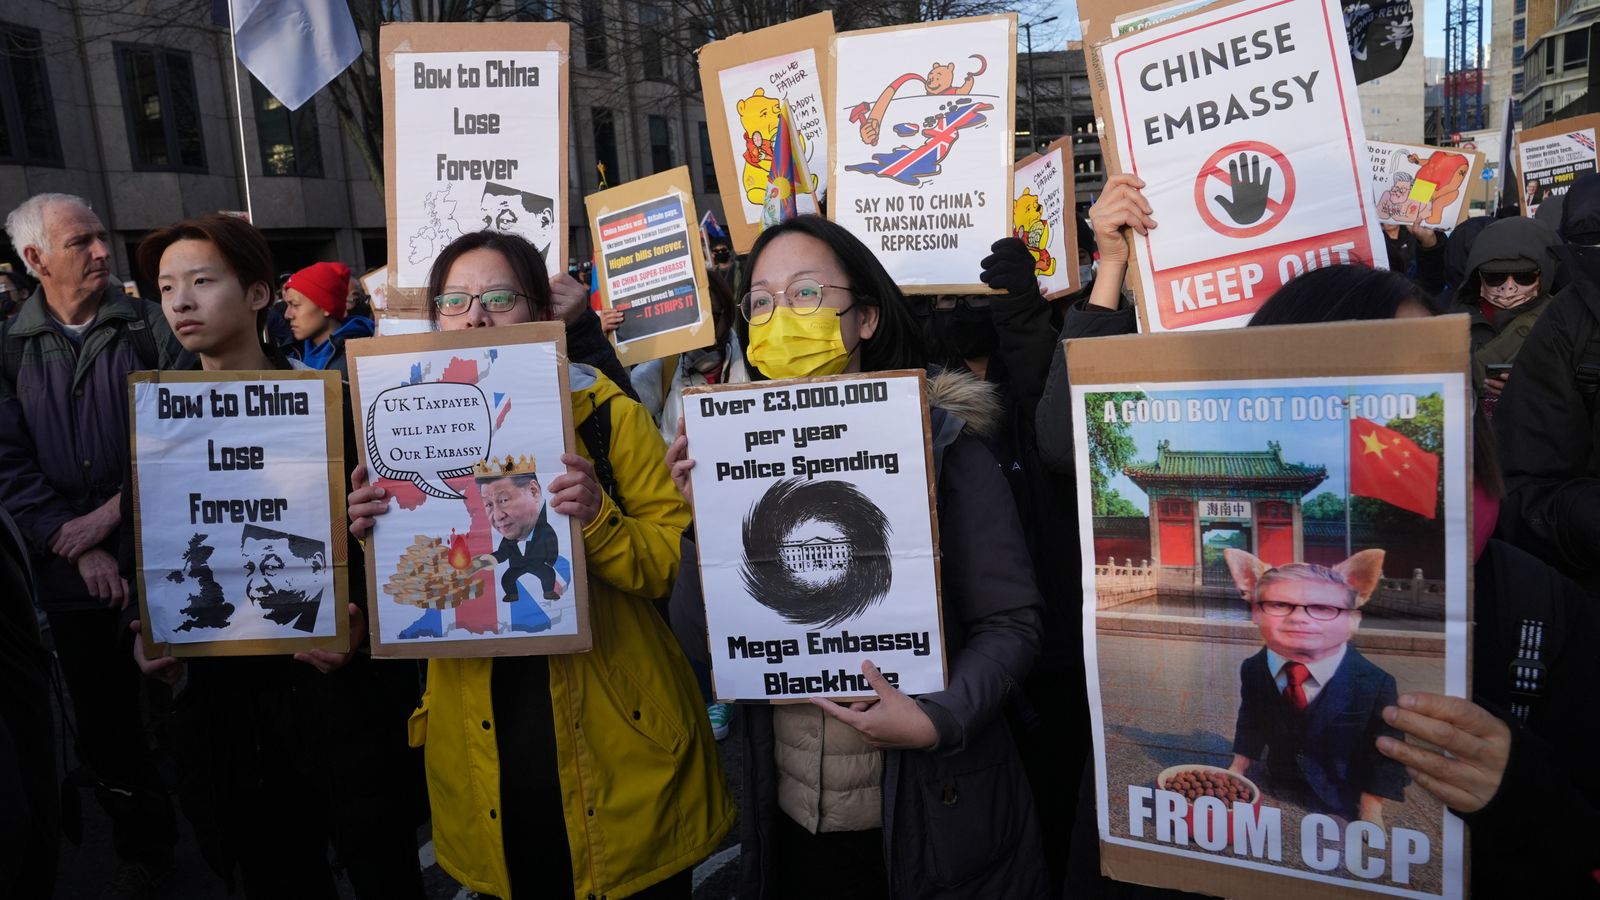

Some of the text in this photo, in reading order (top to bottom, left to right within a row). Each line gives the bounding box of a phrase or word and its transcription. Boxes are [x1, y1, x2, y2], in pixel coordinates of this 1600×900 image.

[1139, 22, 1295, 92] CHINESE
[414, 60, 539, 89] Bow to China
[769, 69, 787, 84] CALL
[776, 69, 808, 93] FATHER
[790, 94, 815, 113] DADDY
[795, 106, 817, 121] I'M A
[1143, 69, 1319, 146] EMBASSY
[453, 107, 500, 135] Lose
[800, 118, 820, 131] GOOD
[804, 127, 823, 140] BOY!
[436, 153, 519, 181] Forever
[1370, 155, 1386, 165] ing
[1372, 165, 1386, 173] UK
[1526, 170, 1551, 180] Starmer
[1574, 161, 1593, 171] China
[1539, 172, 1575, 185] THEY PROFIT
[854, 190, 986, 214] SAY NO TO CHINA'S
[865, 213, 974, 232] TRANSNATIONAL
[609, 240, 685, 270] Higher bills forever.
[880, 234, 959, 252] REPRESSION
[612, 260, 687, 289] NO CHINA SUPER-EMBASSY
[1170, 262, 1264, 314] KEEP
[644, 306, 653, 318] IT
[654, 298, 684, 315] STRIPS
[685, 294, 694, 307] IT
[158, 384, 309, 419] Bow to China
[383, 398, 411, 412] UK
[700, 381, 888, 418] Over £3,000,000
[1103, 393, 1417, 423] A GOOD BOY GOT DOG FOOD
[744, 422, 848, 452] per year
[207, 439, 264, 471] Lose
[716, 450, 899, 481] Police Spending
[188, 492, 288, 524] Forever
[727, 630, 931, 664] Mega Embassy
[764, 667, 900, 695] Blackhoe
[1128, 784, 1430, 884] FROM CCP
